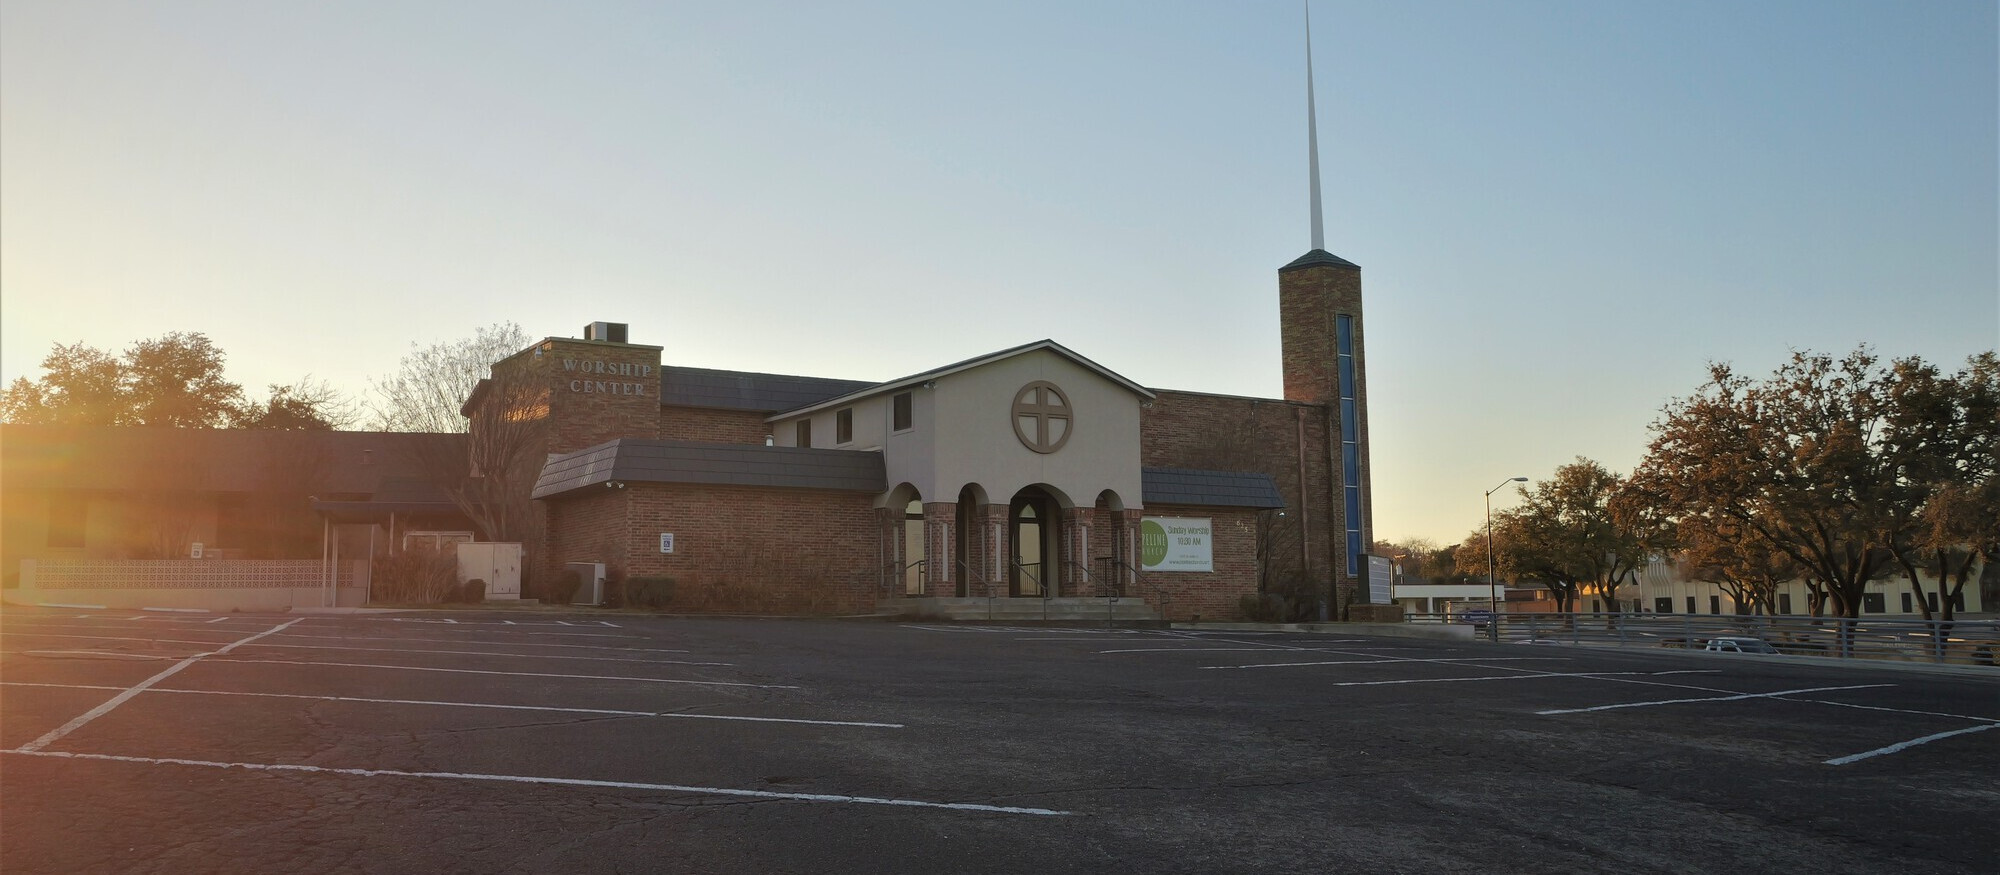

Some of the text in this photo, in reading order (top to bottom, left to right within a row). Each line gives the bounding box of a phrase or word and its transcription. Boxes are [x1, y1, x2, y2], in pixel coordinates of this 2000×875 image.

[563, 359, 652, 377] WORSHIP
[570, 380, 644, 396] CENTER
[1167, 525, 1209, 536] Sunday Worship
[1192, 537, 1202, 546] AM
